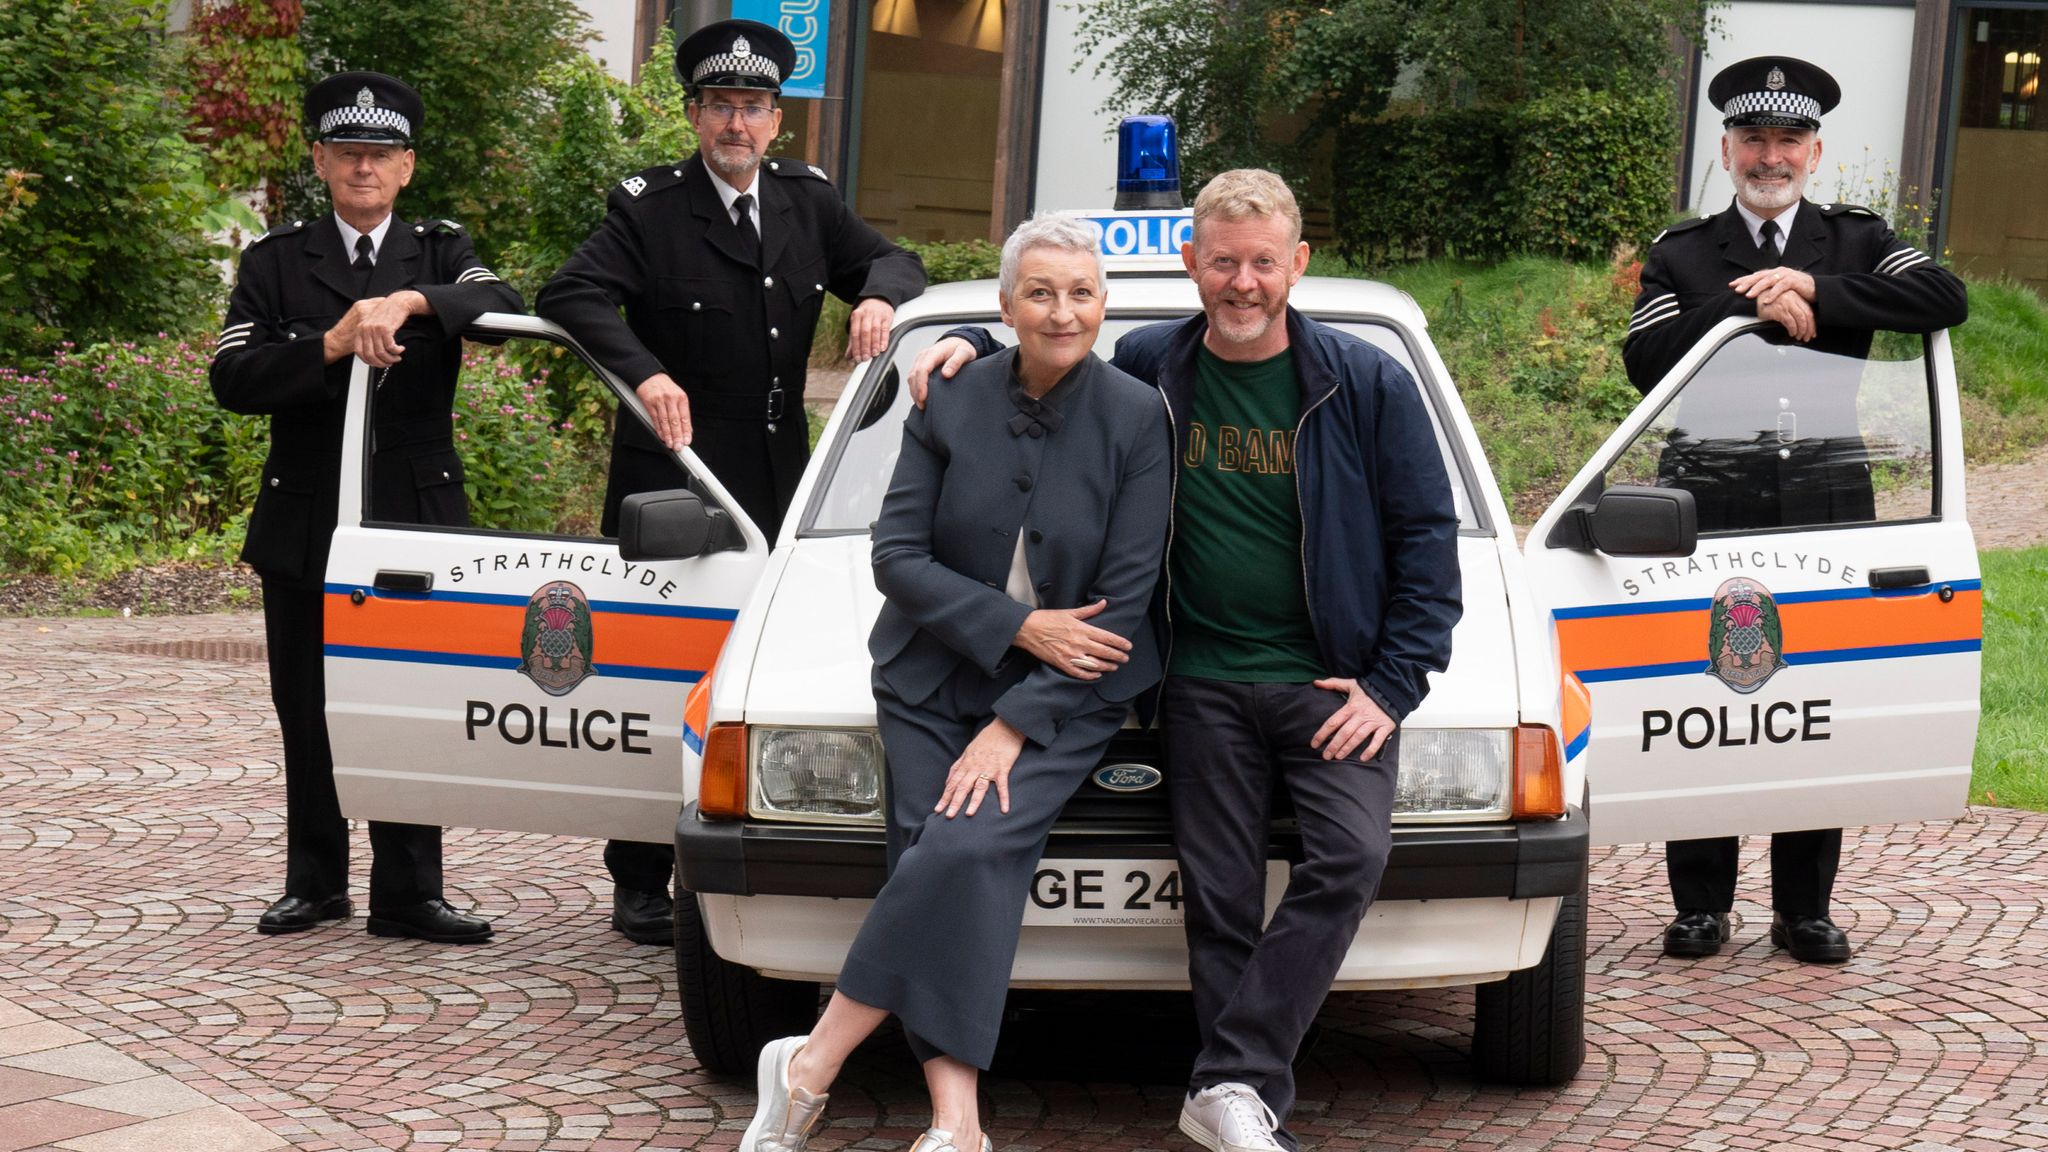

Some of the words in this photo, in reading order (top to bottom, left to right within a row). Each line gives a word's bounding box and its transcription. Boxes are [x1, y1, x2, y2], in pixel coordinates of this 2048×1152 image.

[450, 552, 677, 599] STRATHCLYDE
[1623, 551, 1857, 597] STRATHCLYDE
[466, 700, 652, 755] POLICE
[1641, 699, 1831, 752] POLICE
[1109, 768, 1146, 784] Ford
[1030, 869, 1104, 909] GE
[1123, 870, 1183, 910] 24
